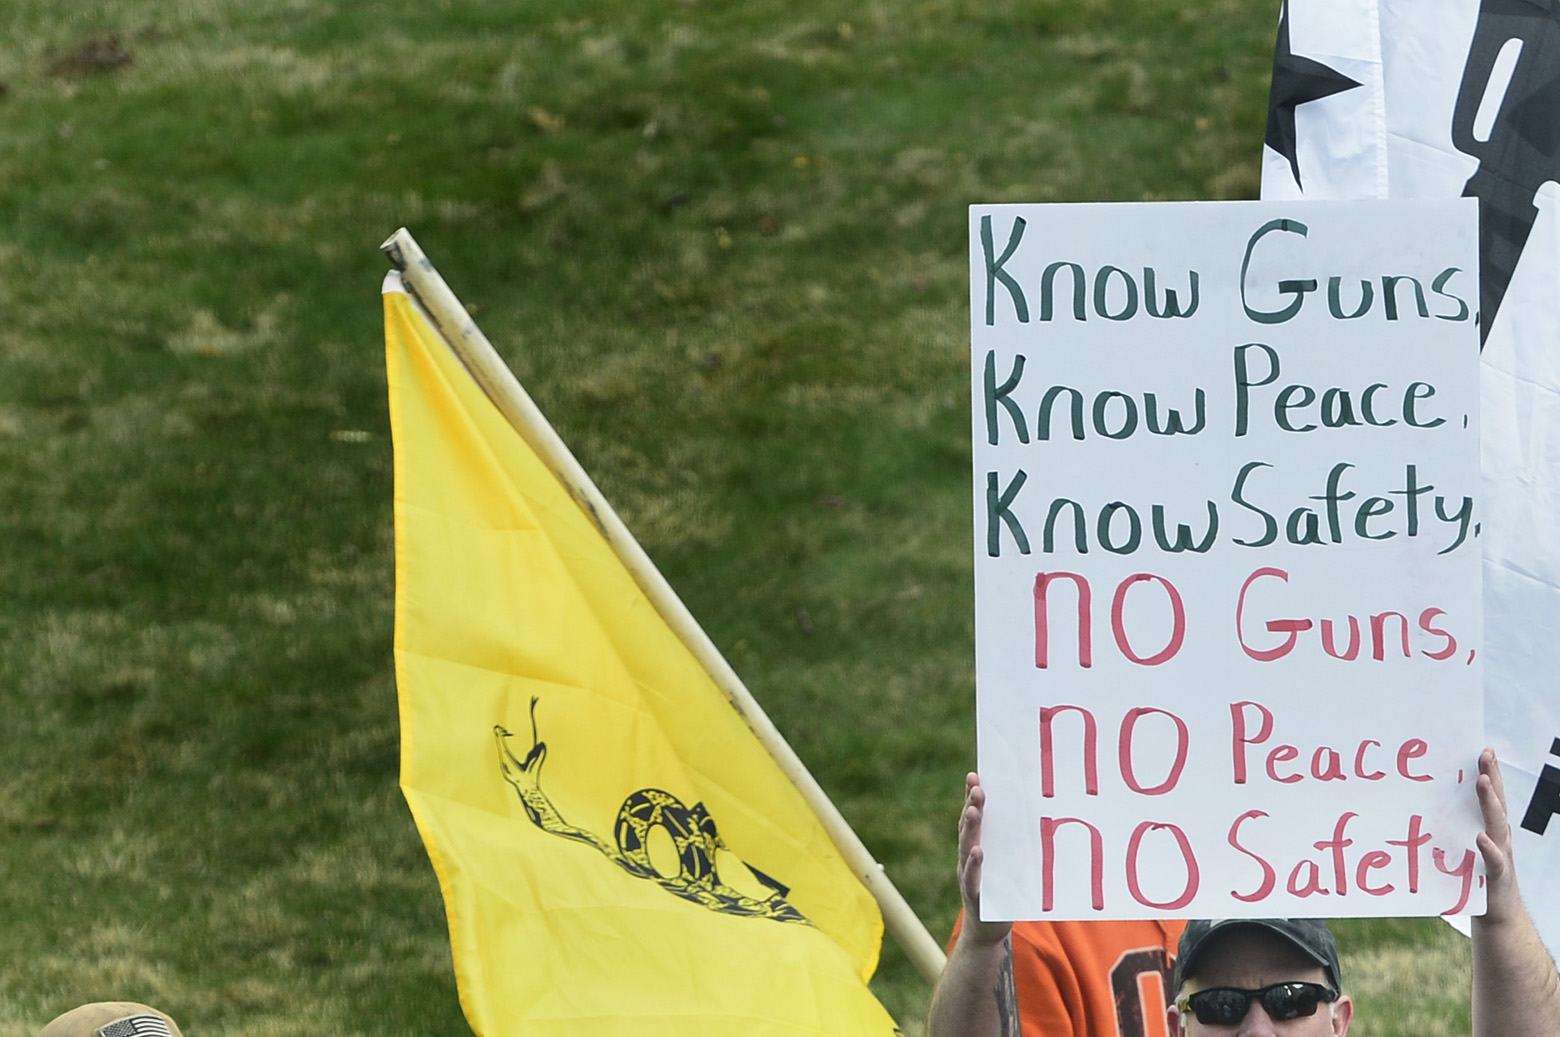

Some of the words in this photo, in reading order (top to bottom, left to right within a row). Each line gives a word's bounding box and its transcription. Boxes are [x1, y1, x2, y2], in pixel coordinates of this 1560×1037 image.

[980, 215, 1199, 326] Know
[983, 349, 1206, 446] Know
[986, 469, 1219, 558] Know
